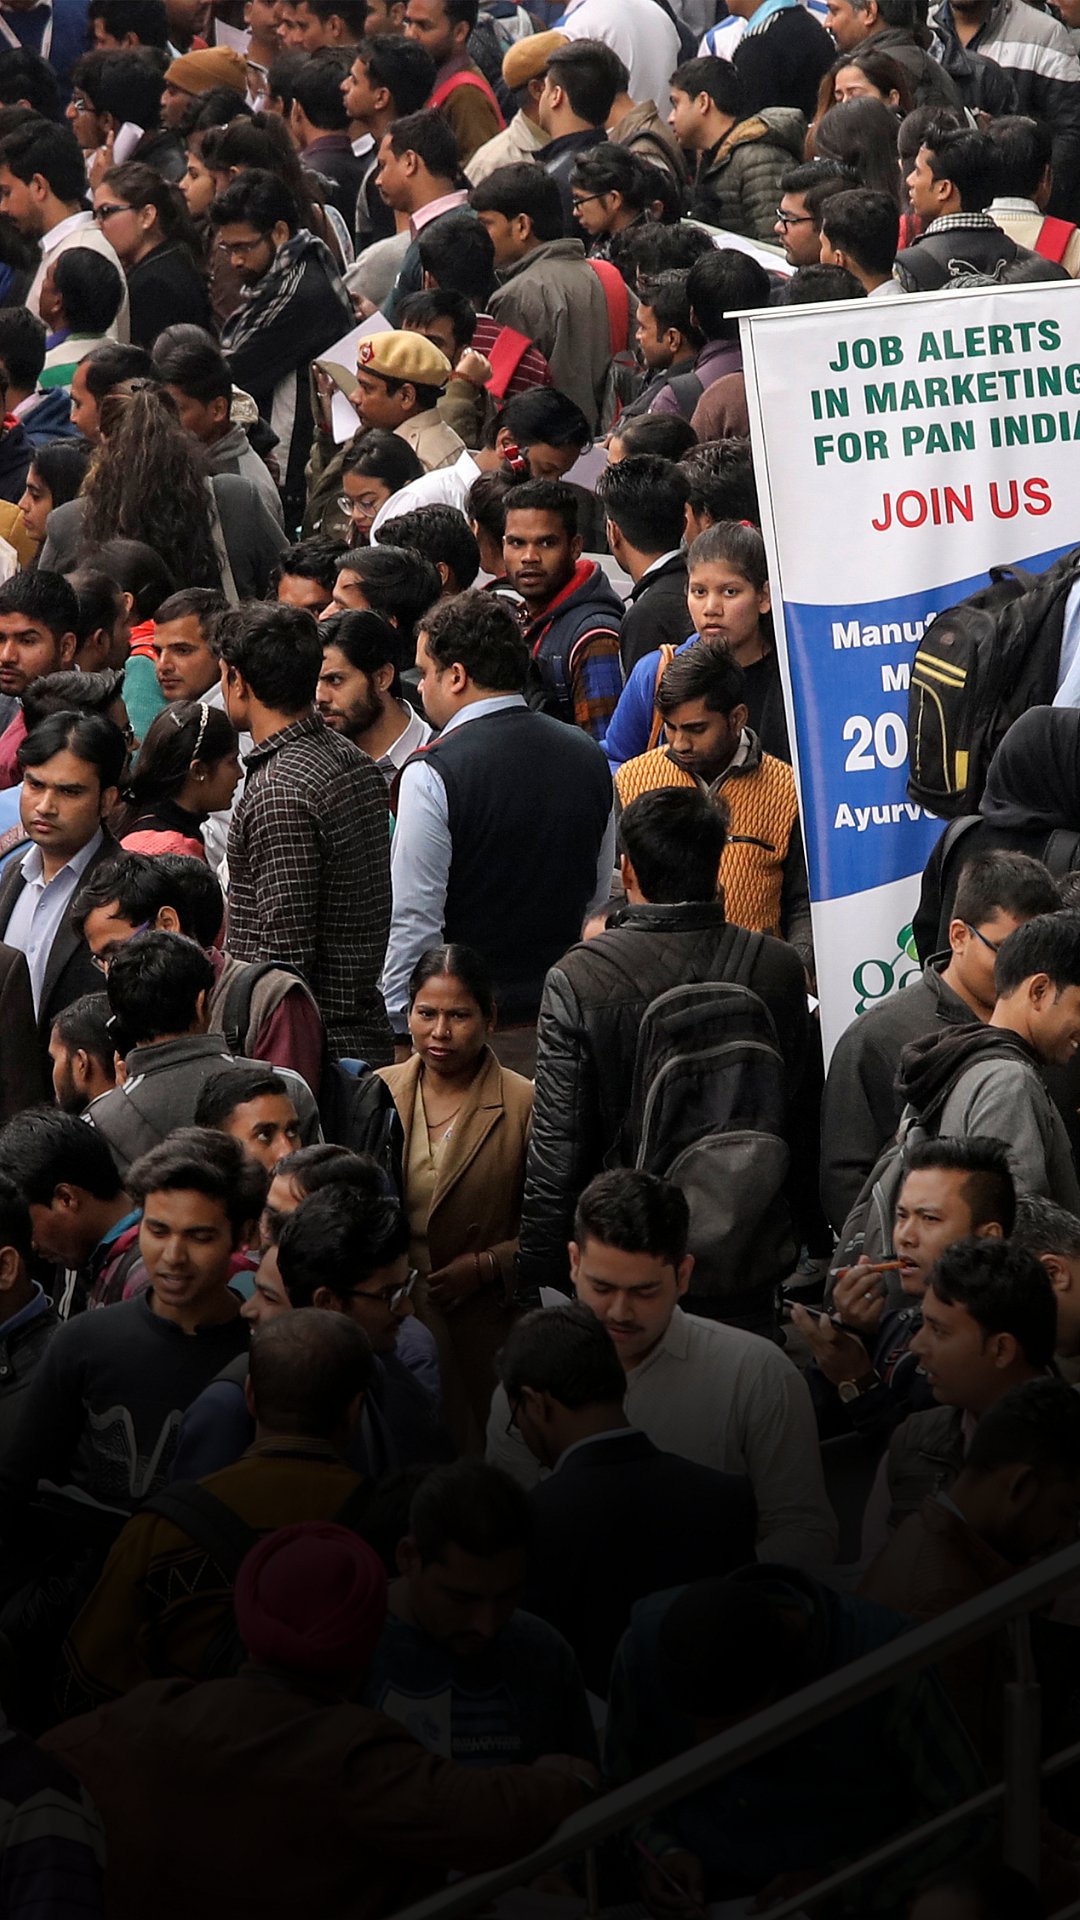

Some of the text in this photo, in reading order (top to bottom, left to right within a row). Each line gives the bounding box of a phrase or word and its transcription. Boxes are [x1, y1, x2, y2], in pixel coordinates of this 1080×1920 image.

[828, 319, 1062, 373] JOB ALERTS
[810, 363, 1080, 420] IN MARKETING
[813, 429, 890, 466] FOR
[902, 420, 976, 457] PAN
[871, 477, 1053, 532] JOIN US
[843, 712, 909, 772] 20
